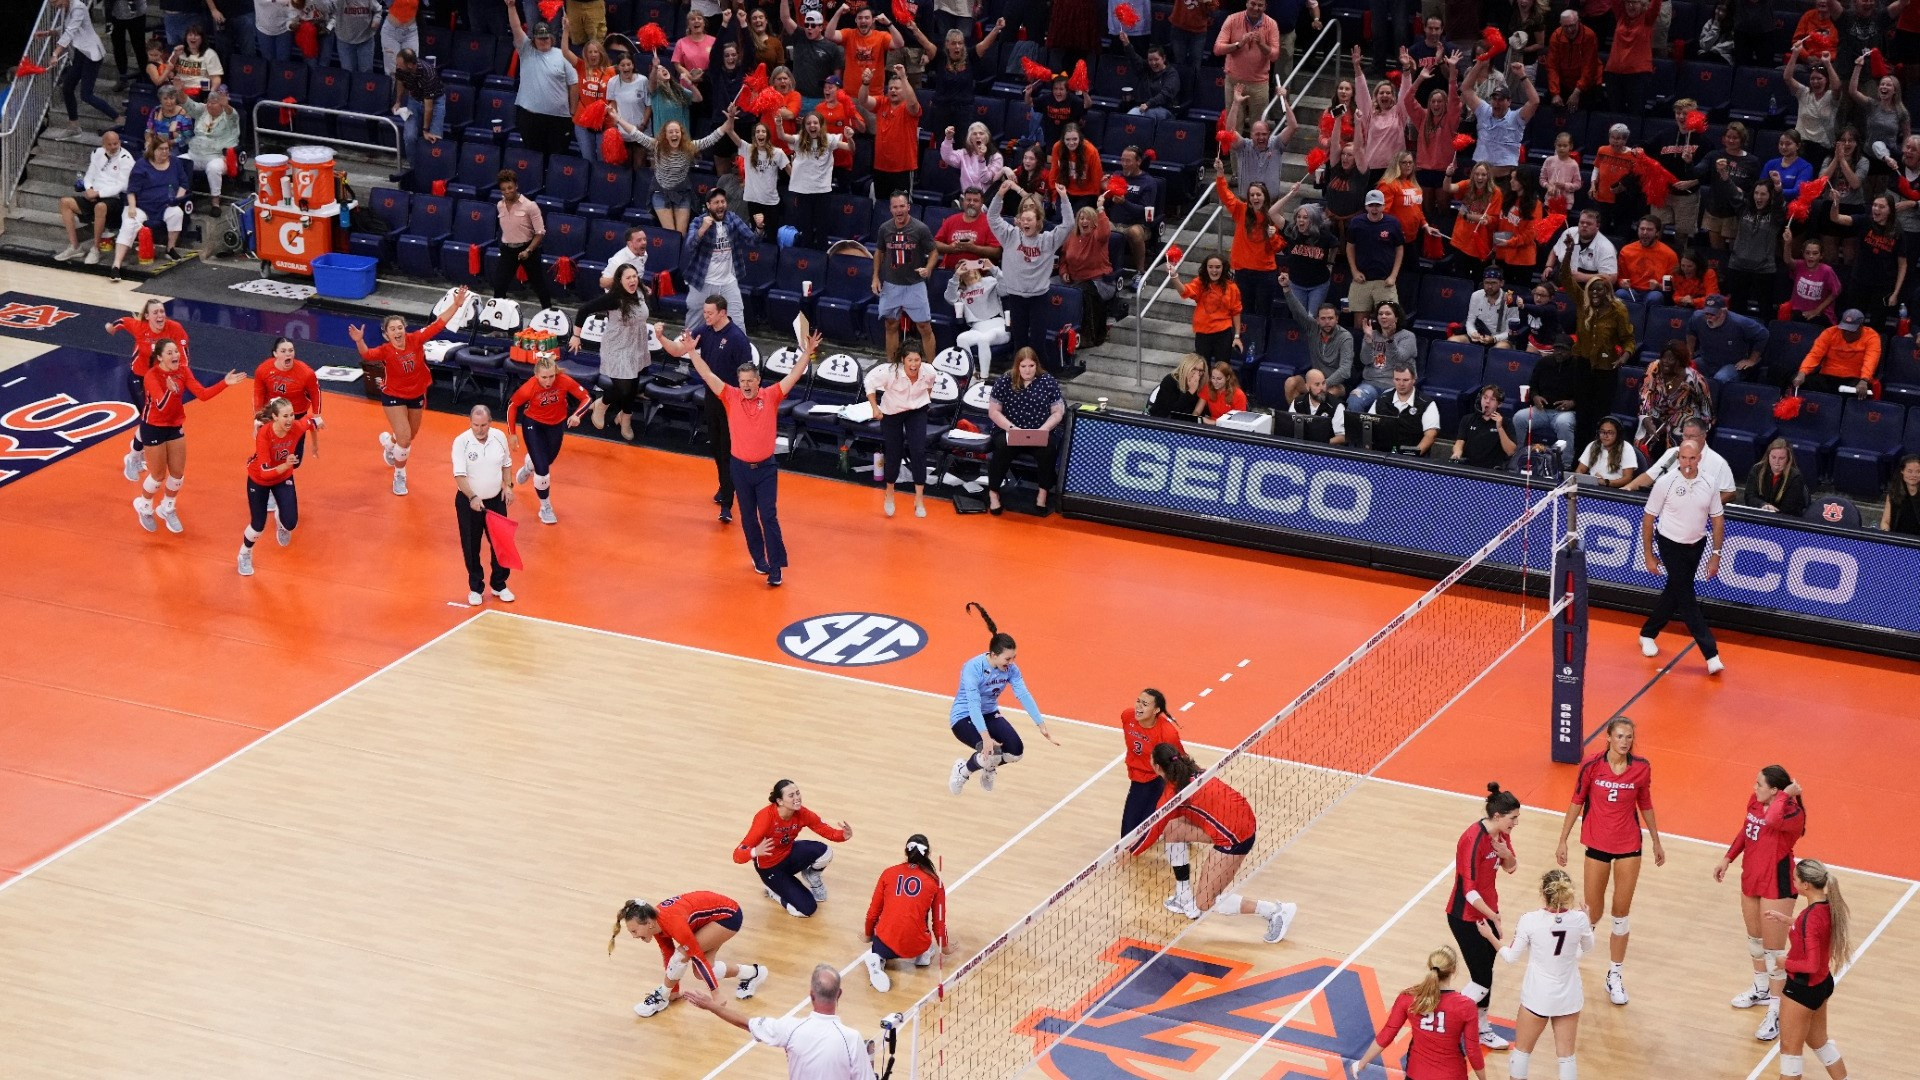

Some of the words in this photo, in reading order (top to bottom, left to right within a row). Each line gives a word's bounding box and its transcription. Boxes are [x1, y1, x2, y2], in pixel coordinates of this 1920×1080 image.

[258, 172, 268, 185] G
[299, 171, 311, 185] G
[279, 222, 305, 255] G
[276, 260, 308, 272] GATORADE
[402, 360, 417, 374] 17
[273, 382, 287, 394] 14
[275, 448, 293, 462] 12
[1110, 437, 1374, 525] GEICO
[1575, 511, 1859, 605] GCO
[785, 614, 919, 663] SEC
[1560, 703, 1571, 743] senoh
[1133, 741, 1143, 755] 3
[1594, 779, 1635, 790] GEORGIA
[1607, 788, 1618, 802] 2
[1136, 811, 1161, 836] AUBURN
[1745, 823, 1760, 841] 23
[895, 874, 922, 898] 10
[1048, 880, 1075, 906] AUBURN
[1075, 861, 1099, 885] TIGERS
[1551, 930, 1567, 956] 7
[954, 954, 983, 981] AUBURN
[984, 933, 1009, 958] TIGERS
[1419, 1011, 1446, 1034] 21
